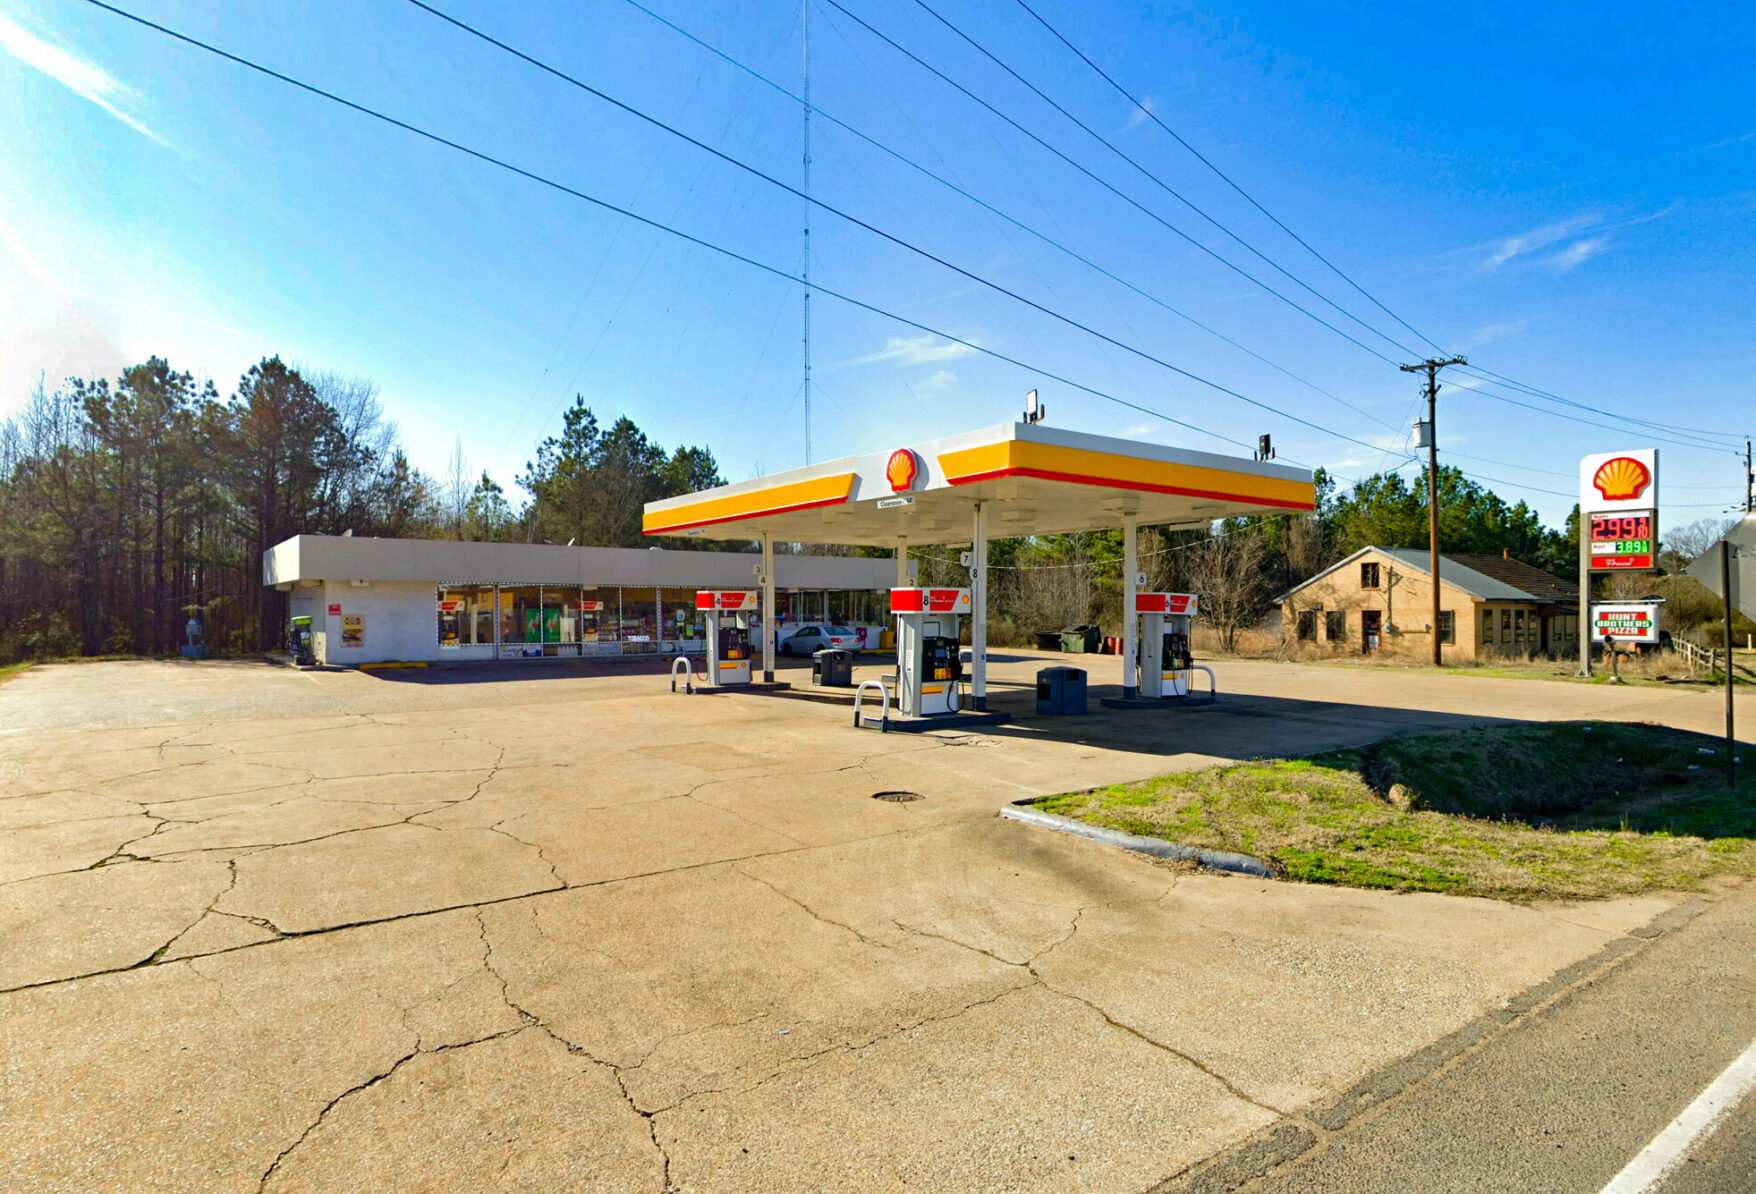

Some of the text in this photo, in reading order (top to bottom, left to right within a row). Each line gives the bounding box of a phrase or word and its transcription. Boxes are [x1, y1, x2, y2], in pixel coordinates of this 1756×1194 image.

[964, 555, 969, 563] 7
[972, 568, 978, 578] 8
[760, 576, 766, 584] 4
[1139, 574, 1144, 583] 6
[715, 597, 721, 605] 4
[923, 595, 929, 606] 8
